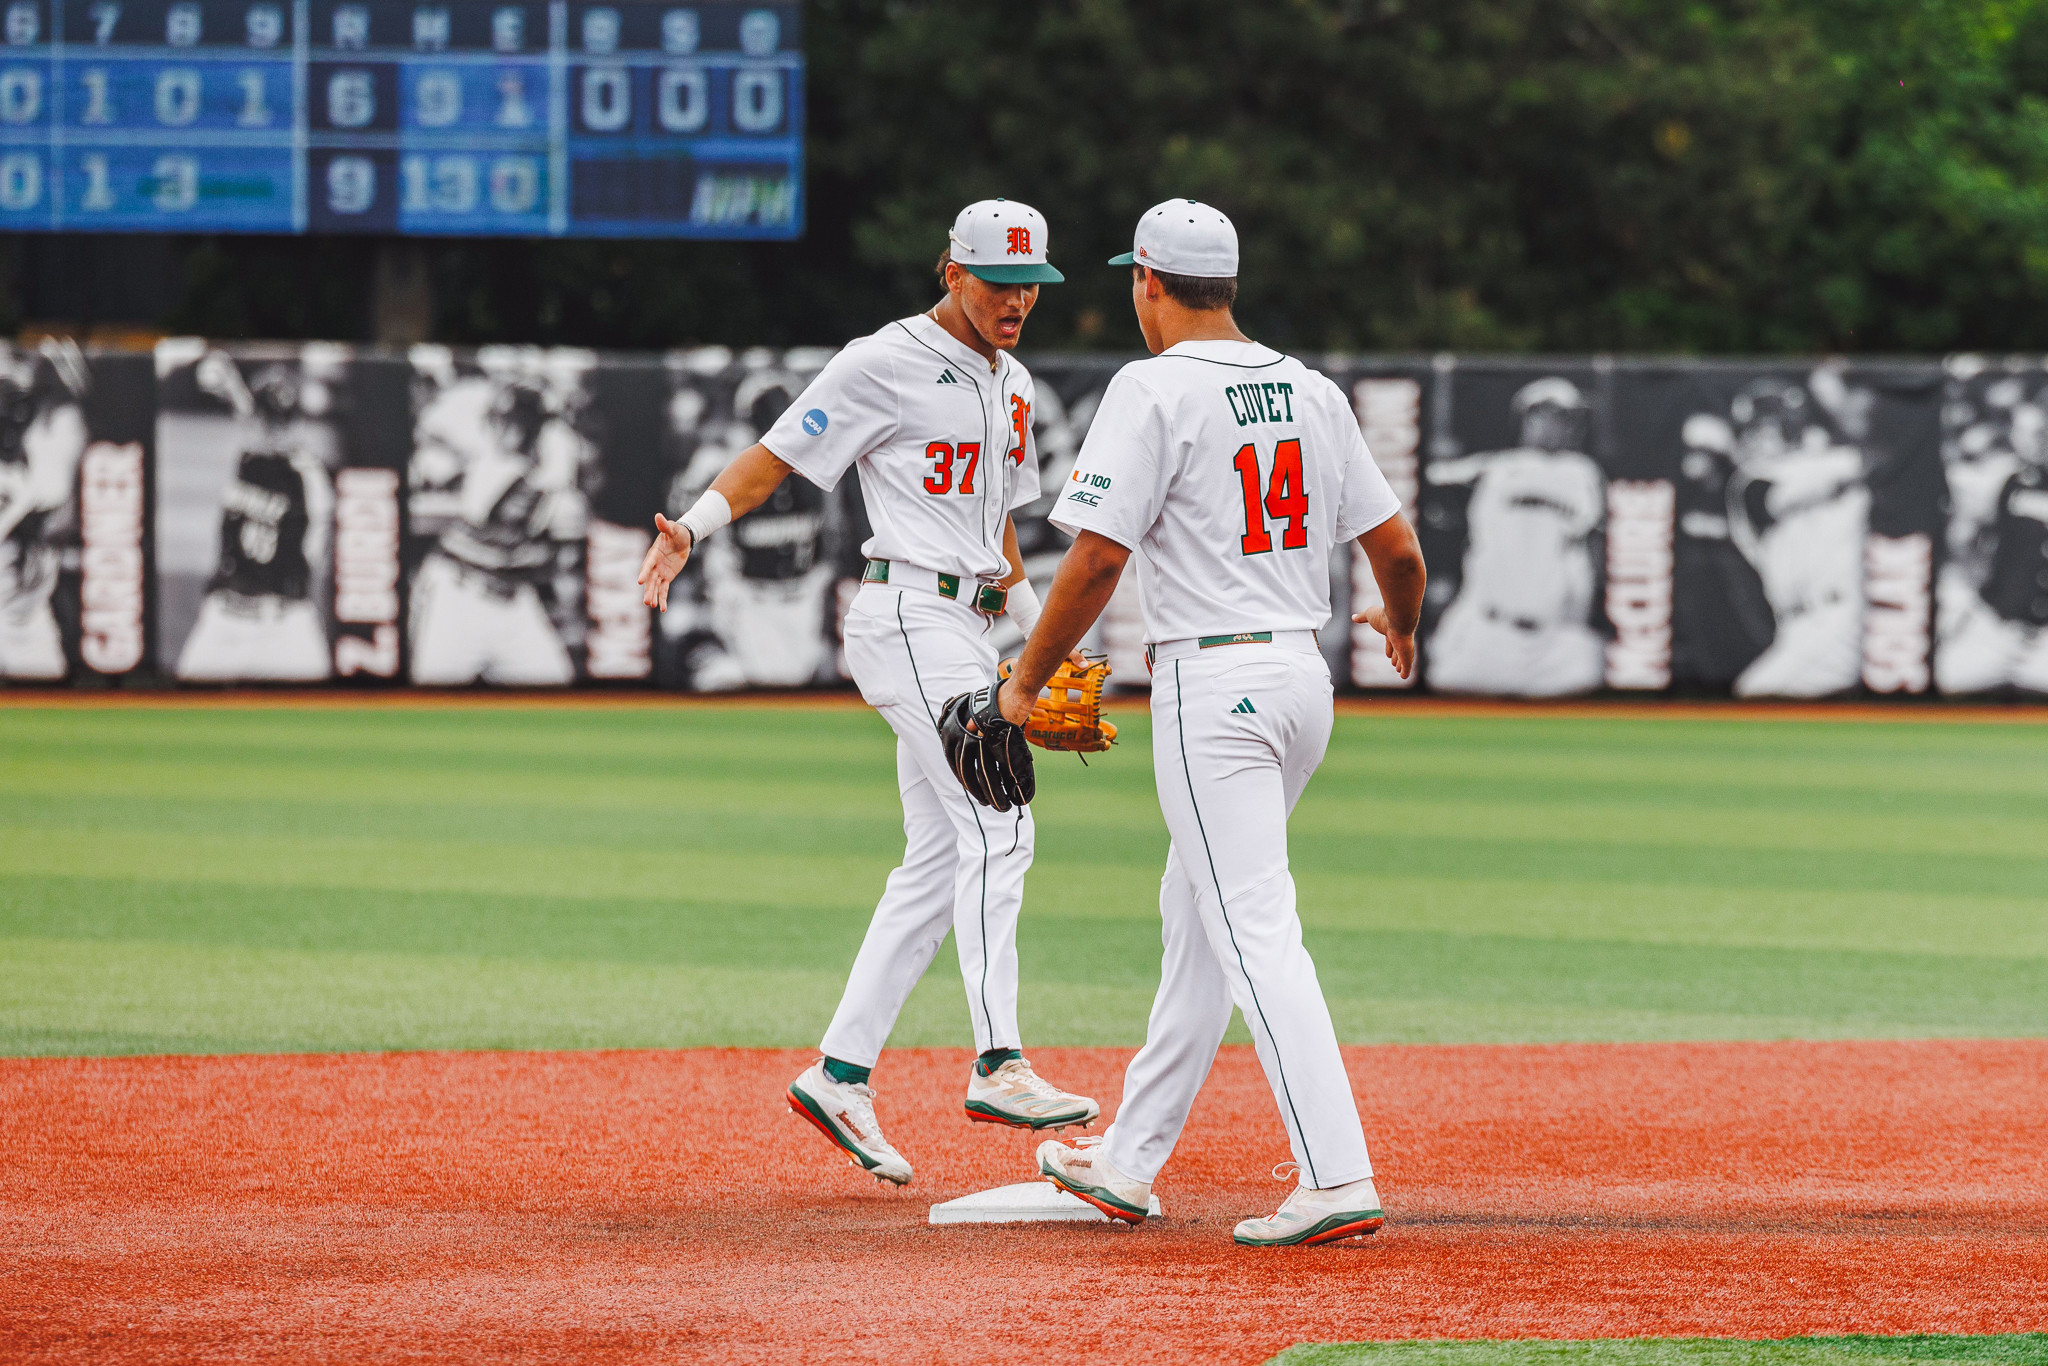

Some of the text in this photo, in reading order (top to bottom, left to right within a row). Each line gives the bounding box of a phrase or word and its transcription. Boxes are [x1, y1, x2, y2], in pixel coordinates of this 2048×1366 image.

[90, 4, 120, 45] 7
[246, 6, 283, 48] 9
[492, 8, 525, 50] E
[0, 67, 273, 127] 0 1 0 1
[327, 70, 534, 127] 6 9 1
[581, 70, 784, 132] 0 0 0
[0, 153, 199, 211] 0 1 3
[327, 154, 538, 213] 9 13 0
[804, 415, 823, 434] NCAA
[1225, 382, 1293, 427] CUVET
[923, 442, 980, 494] 37
[1090, 474, 1111, 490] 100
[1067, 490, 1103, 507] ACC
[1233, 438, 1308, 556] 14
[81, 441, 144, 673] GARDNER
[334, 467, 399, 622] BURDI
[1862, 532, 1932, 693] SOLAK
